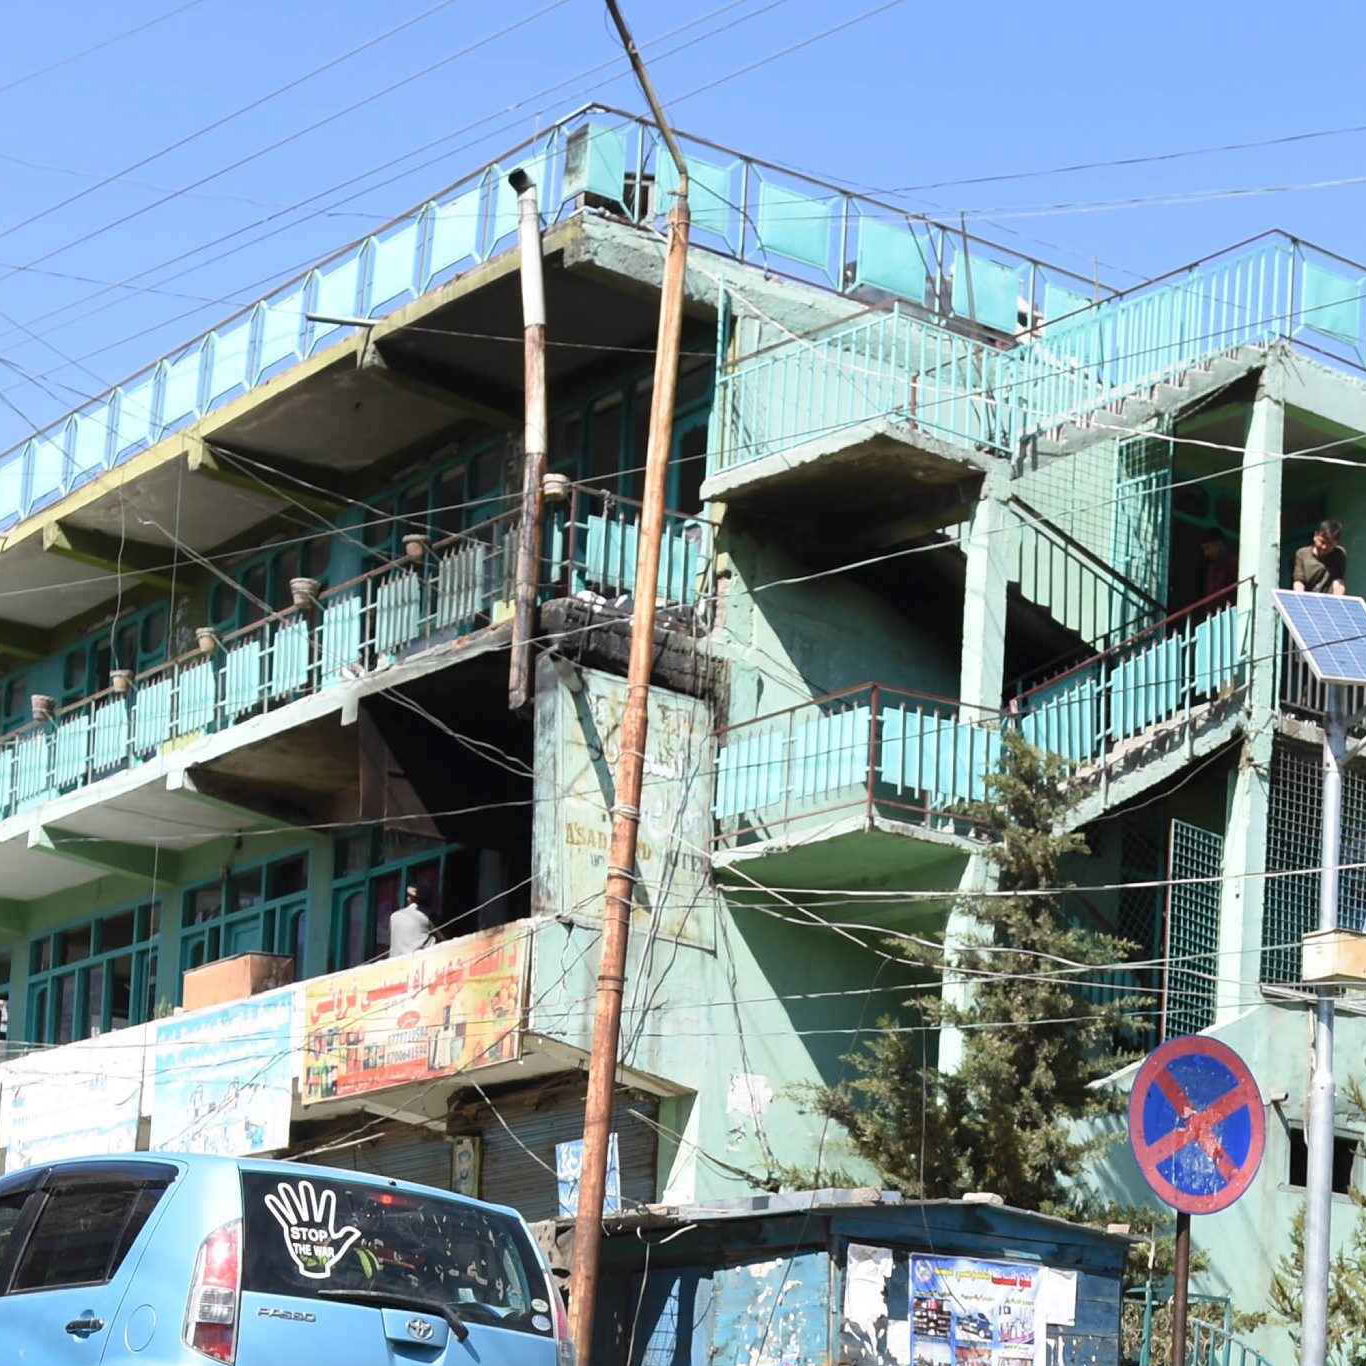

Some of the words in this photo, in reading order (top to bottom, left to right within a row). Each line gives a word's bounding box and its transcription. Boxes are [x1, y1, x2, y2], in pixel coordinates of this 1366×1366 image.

[291, 1227, 328, 1242] STOP
[293, 1243, 312, 1256] THE
[313, 1245, 335, 1259] WAR
